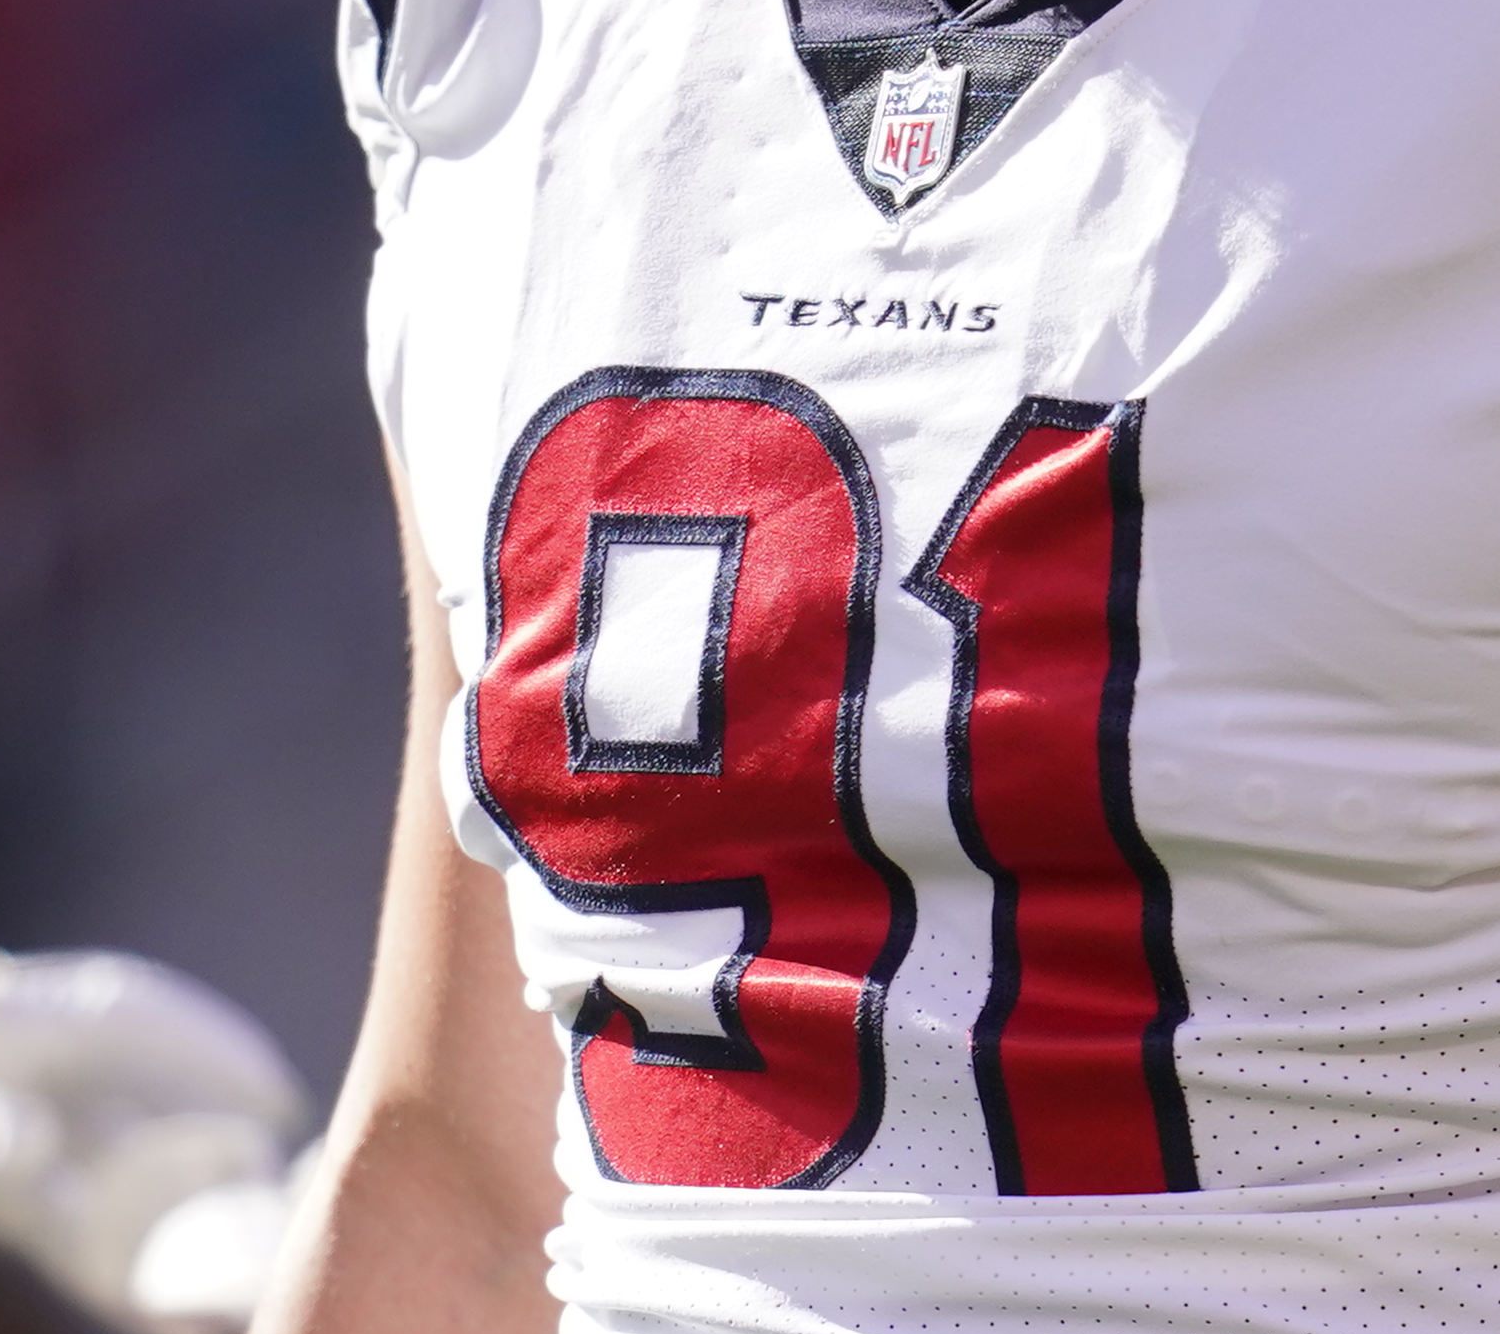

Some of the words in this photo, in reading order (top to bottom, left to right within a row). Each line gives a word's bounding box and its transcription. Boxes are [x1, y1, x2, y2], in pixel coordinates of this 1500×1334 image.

[880, 118, 937, 172] NFL
[740, 288, 1003, 334] TEXANS
[465, 364, 1202, 1198] 91
